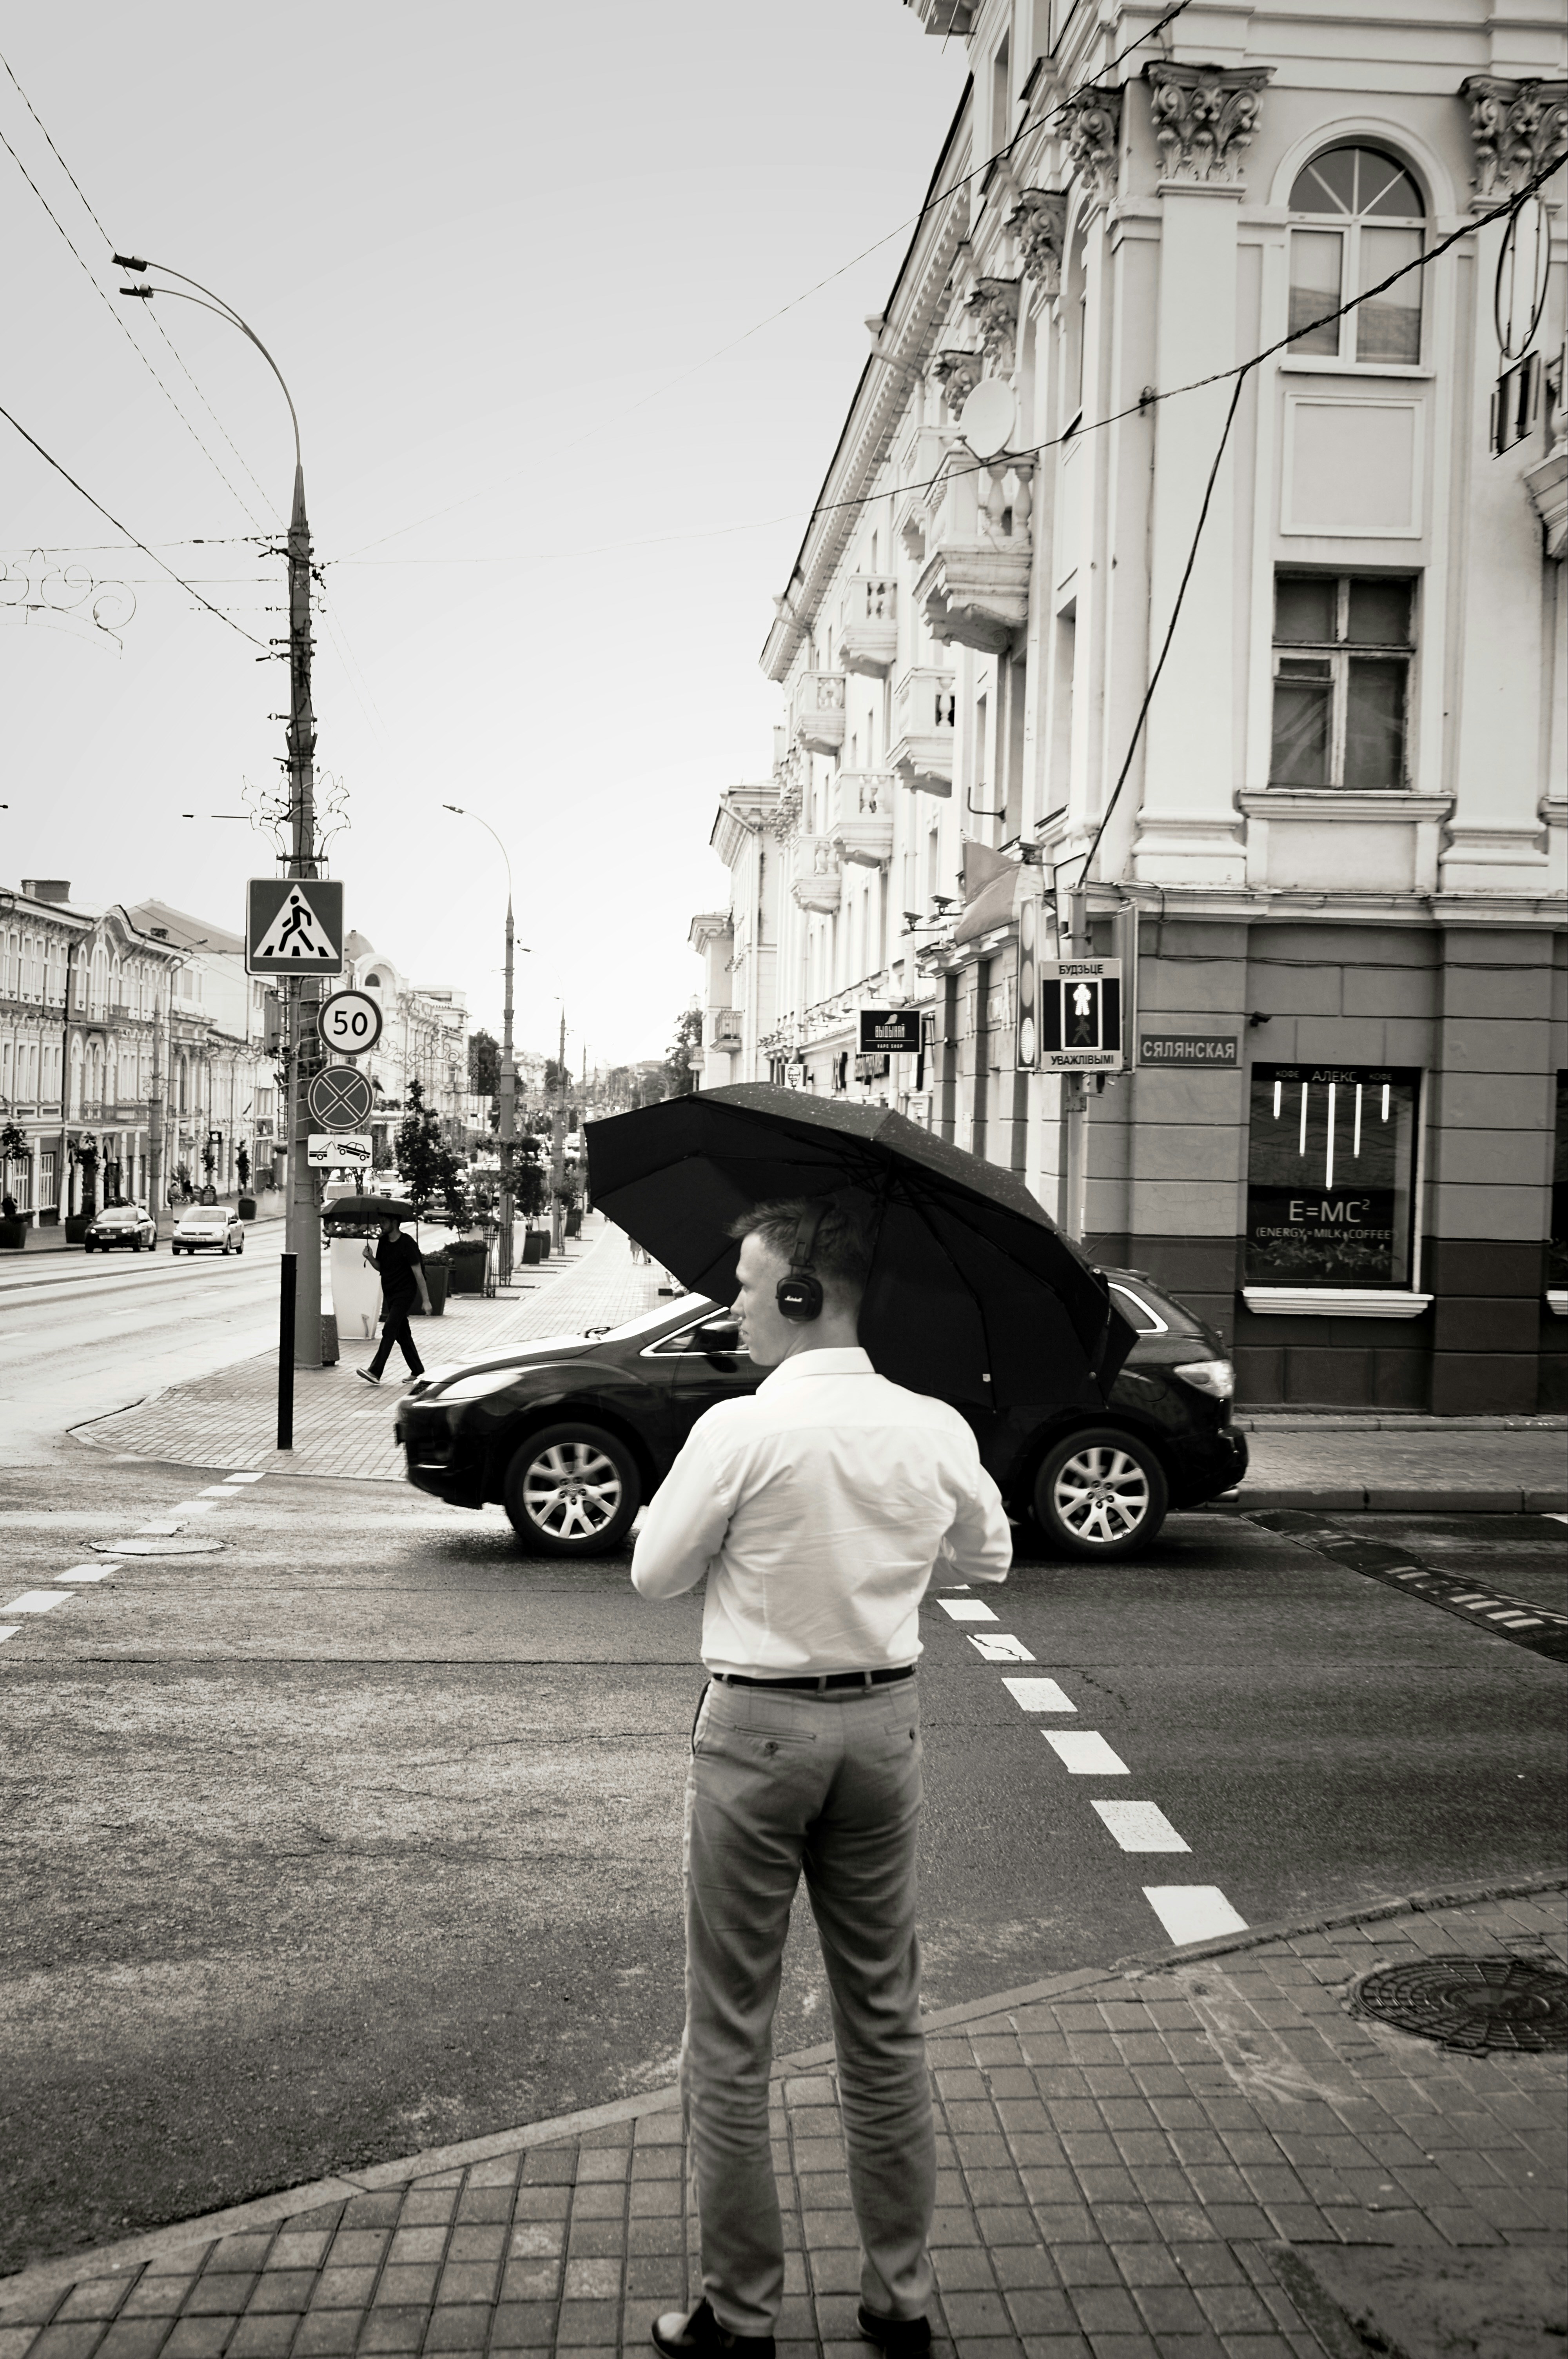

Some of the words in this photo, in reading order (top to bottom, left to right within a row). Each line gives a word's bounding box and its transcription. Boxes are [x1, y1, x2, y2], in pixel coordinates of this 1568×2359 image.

[1059, 964, 1103, 976] БУДЗЬЦЕ
[333, 1010, 368, 1036] 50
[1143, 1041, 1235, 1059] СЯЛЯНСКАЯ
[1051, 1055, 1114, 1065] УВАЖЛІВЫМІ
[1312, 1071, 1357, 1082] АЛЕКС
